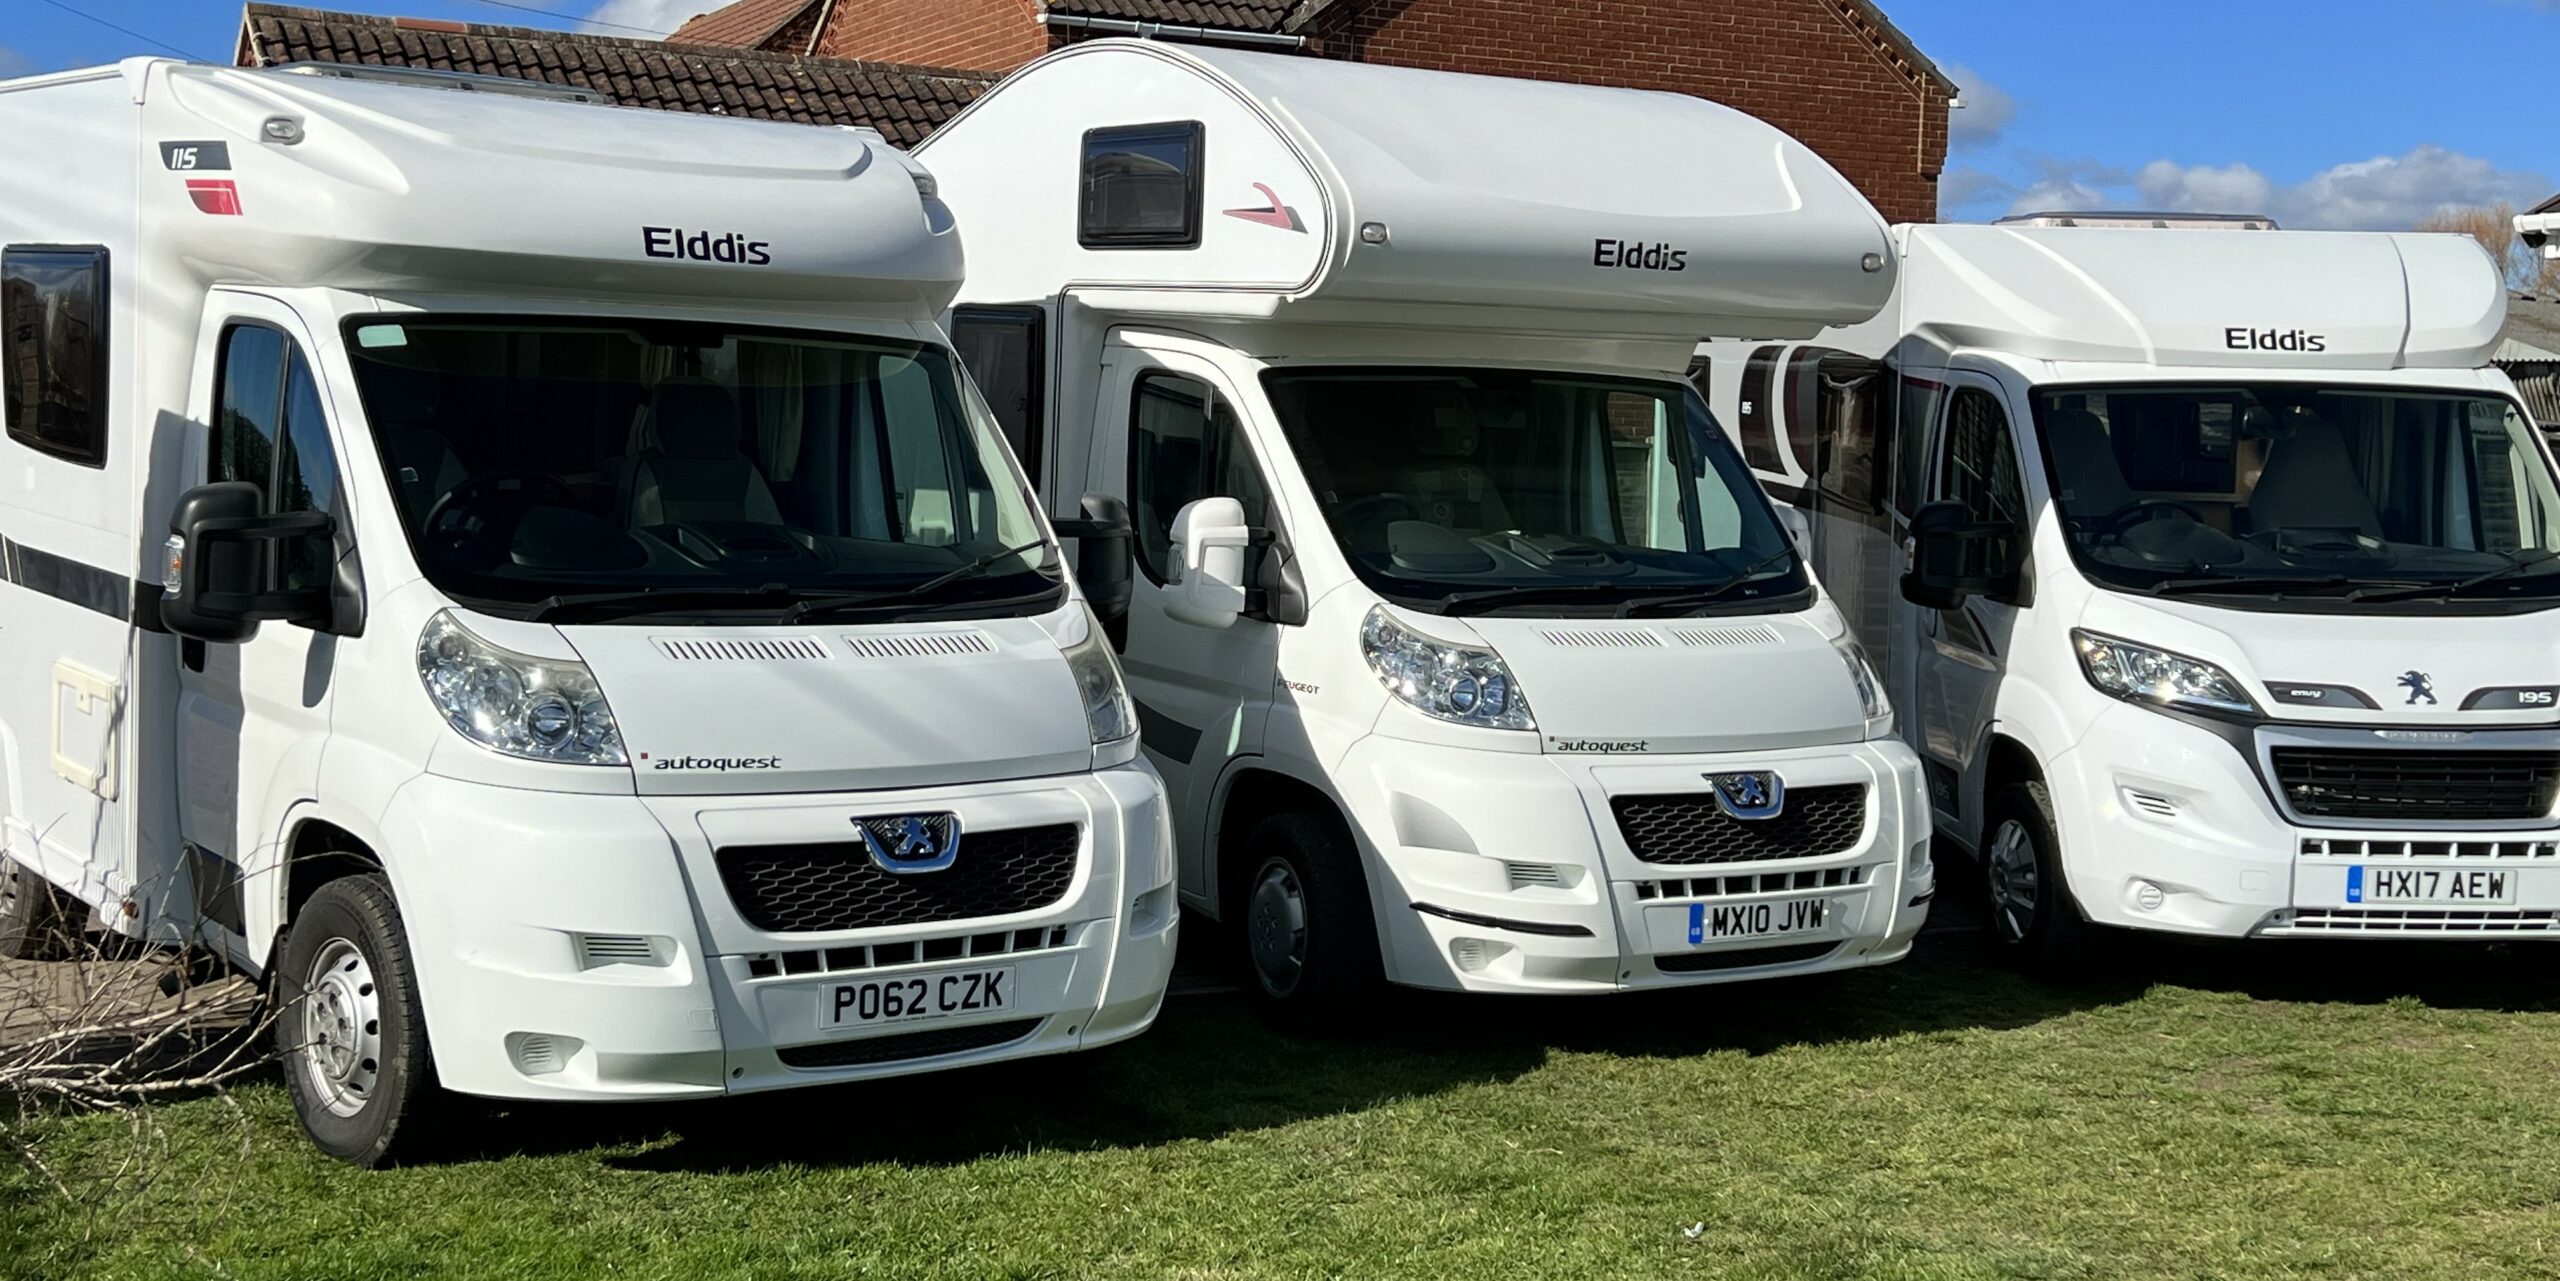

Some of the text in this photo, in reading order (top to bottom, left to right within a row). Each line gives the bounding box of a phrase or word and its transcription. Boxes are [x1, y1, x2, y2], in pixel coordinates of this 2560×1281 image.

[171, 147, 198, 170] 115
[642, 226, 771, 266] Elddis
[1593, 238, 1688, 272] Elddis
[2224, 327, 2326, 352] Elddis
[2290, 689, 2322, 699] envy
[2518, 691, 2553, 704] 195
[1557, 739, 1650, 754] autoquest
[654, 754, 783, 772] autoquest
[2375, 870, 2506, 899] HX17 AEW
[1711, 898, 1824, 937] MX10 JVW
[938, 970, 1005, 1012] CZK
